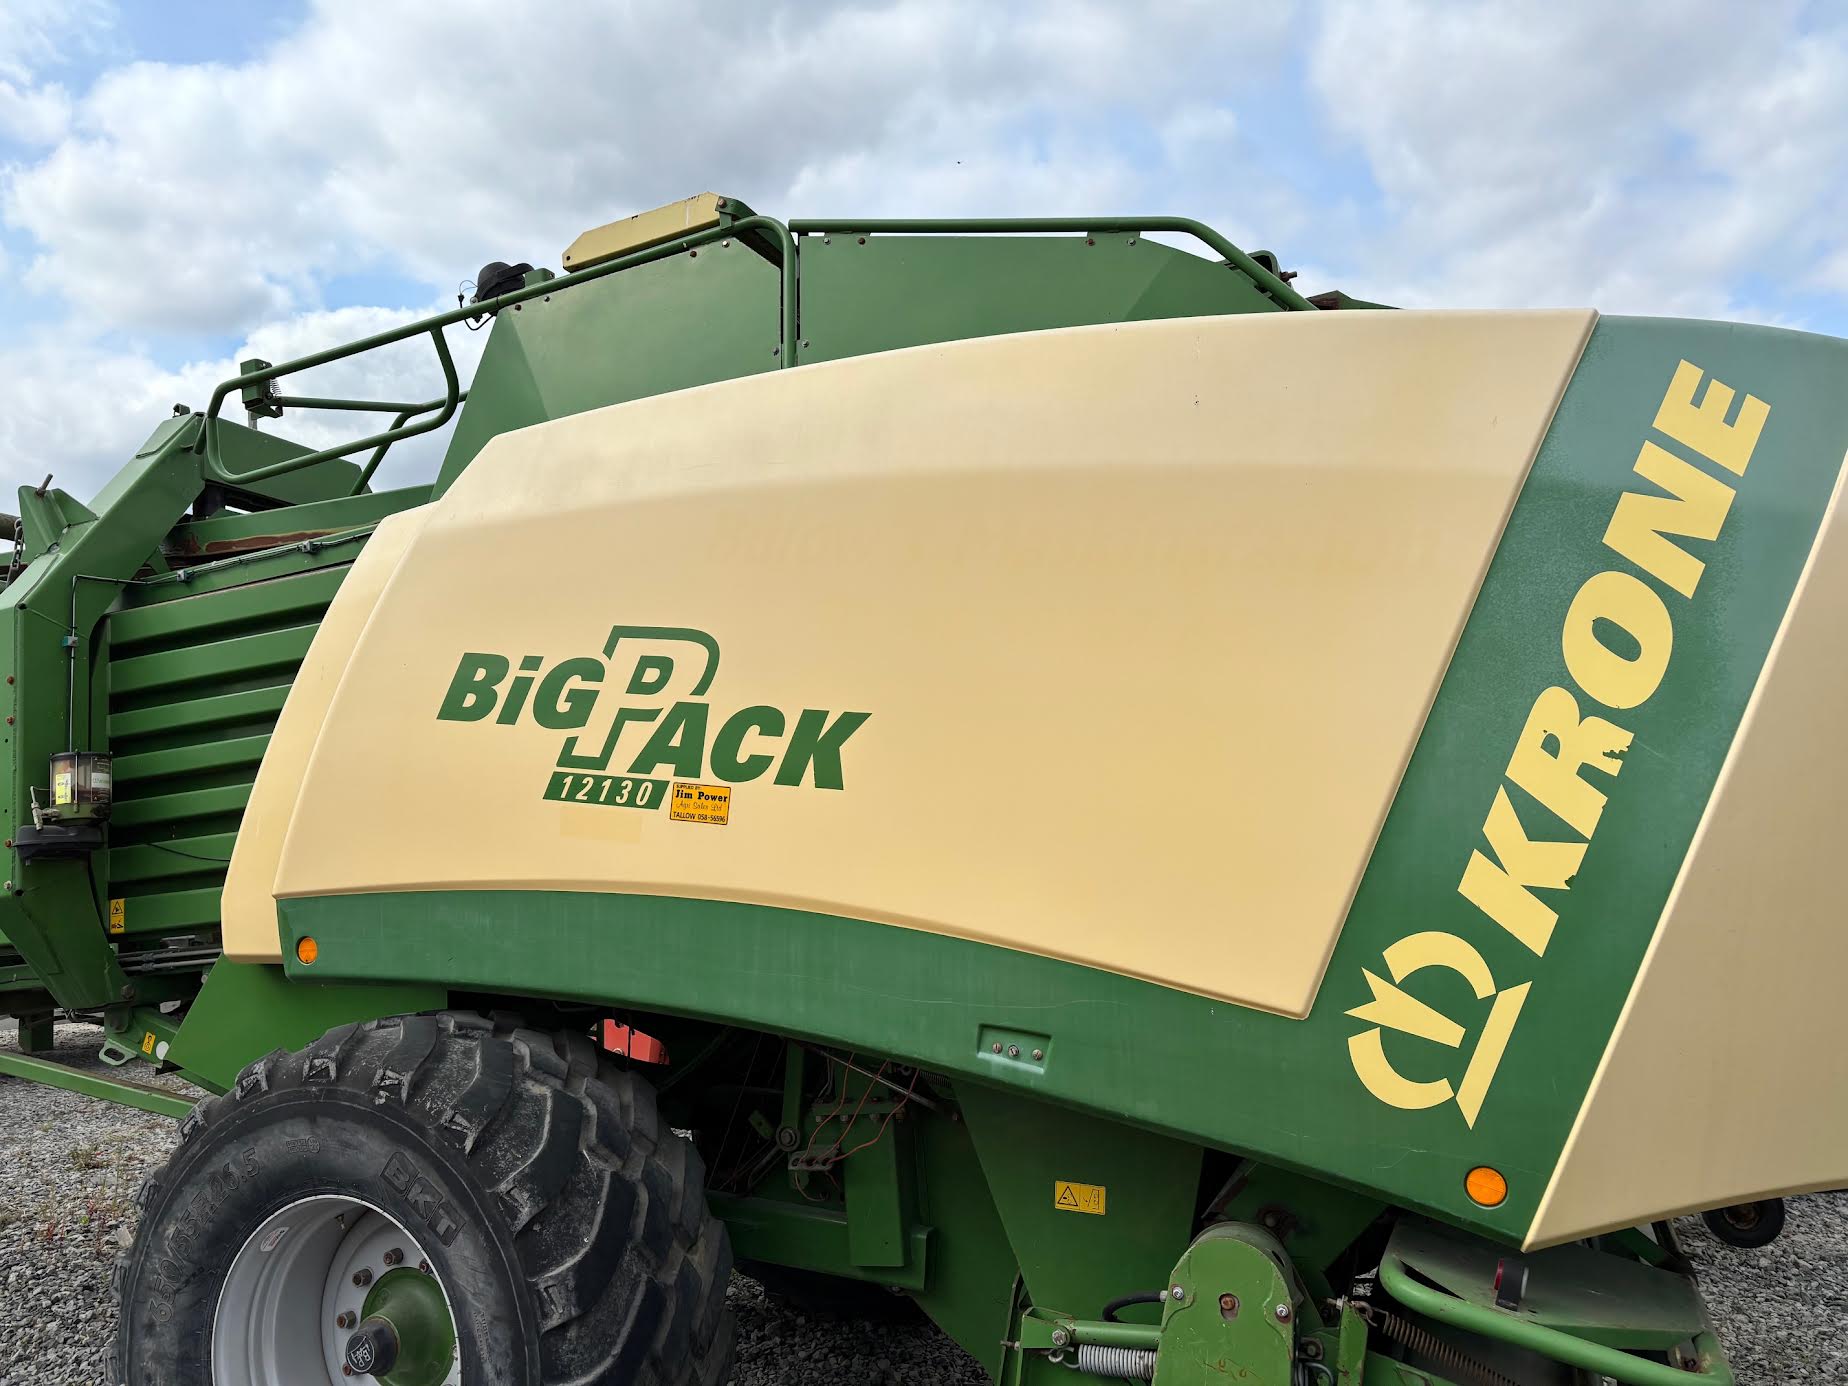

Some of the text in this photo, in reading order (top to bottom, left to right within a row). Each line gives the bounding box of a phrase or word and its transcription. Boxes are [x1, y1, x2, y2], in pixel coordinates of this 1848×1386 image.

[1457, 358, 1771, 957] KRONE
[436, 625, 873, 791] BiG PACK
[560, 775, 653, 806] 12130
[675, 789, 728, 803] Jim Power
[693, 801, 709, 811] Sales
[673, 811, 696, 820] TALLOW
[383, 1157, 458, 1238] BKT
